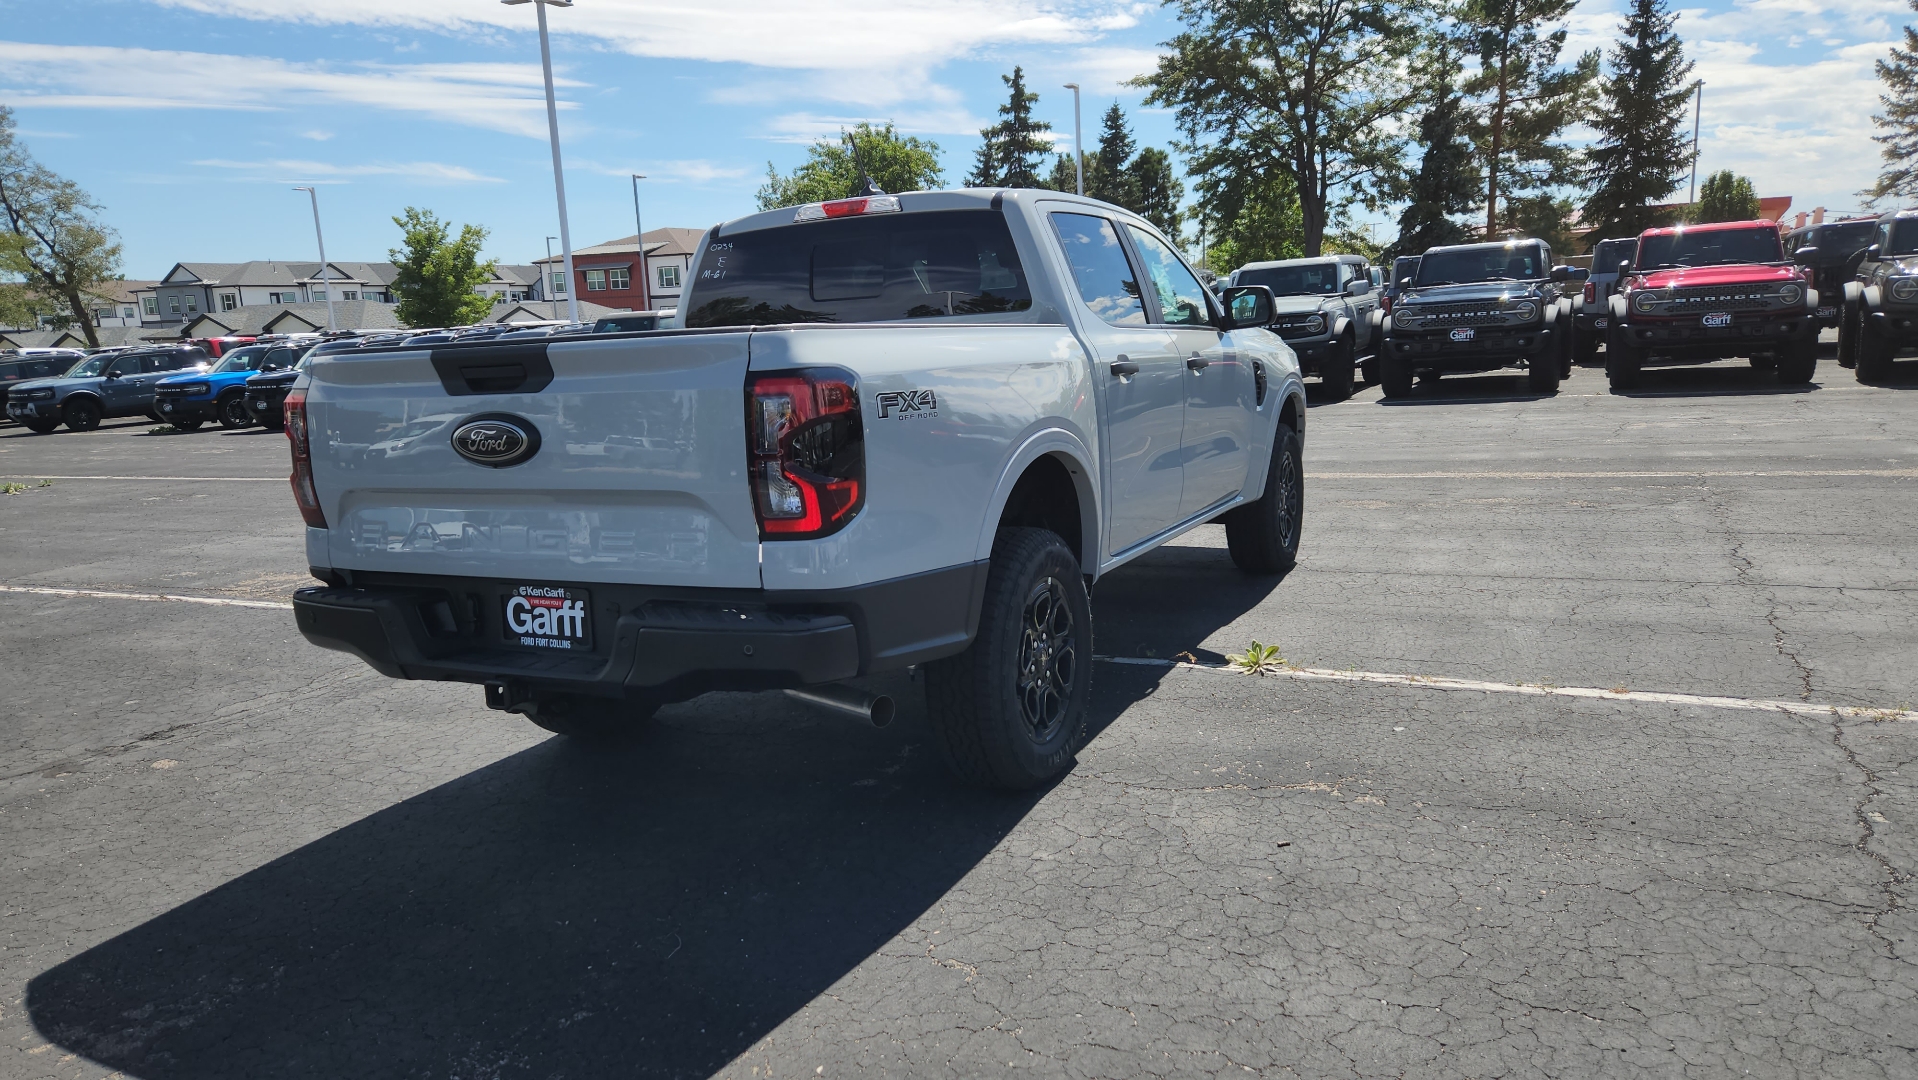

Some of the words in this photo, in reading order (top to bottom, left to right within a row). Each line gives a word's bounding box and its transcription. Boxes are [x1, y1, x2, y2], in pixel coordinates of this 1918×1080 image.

[1675, 294, 1761, 303] BRONCO
[1702, 314, 1732, 325] Garff
[1449, 329, 1475, 340] Garff
[875, 389, 937, 419] FX4
[467, 429, 507, 451] Ford
[506, 596, 585, 638] Garff
[520, 636, 535, 646] FORD
[535, 637, 549, 647] FORT
[549, 638, 571, 649] COLLINS
